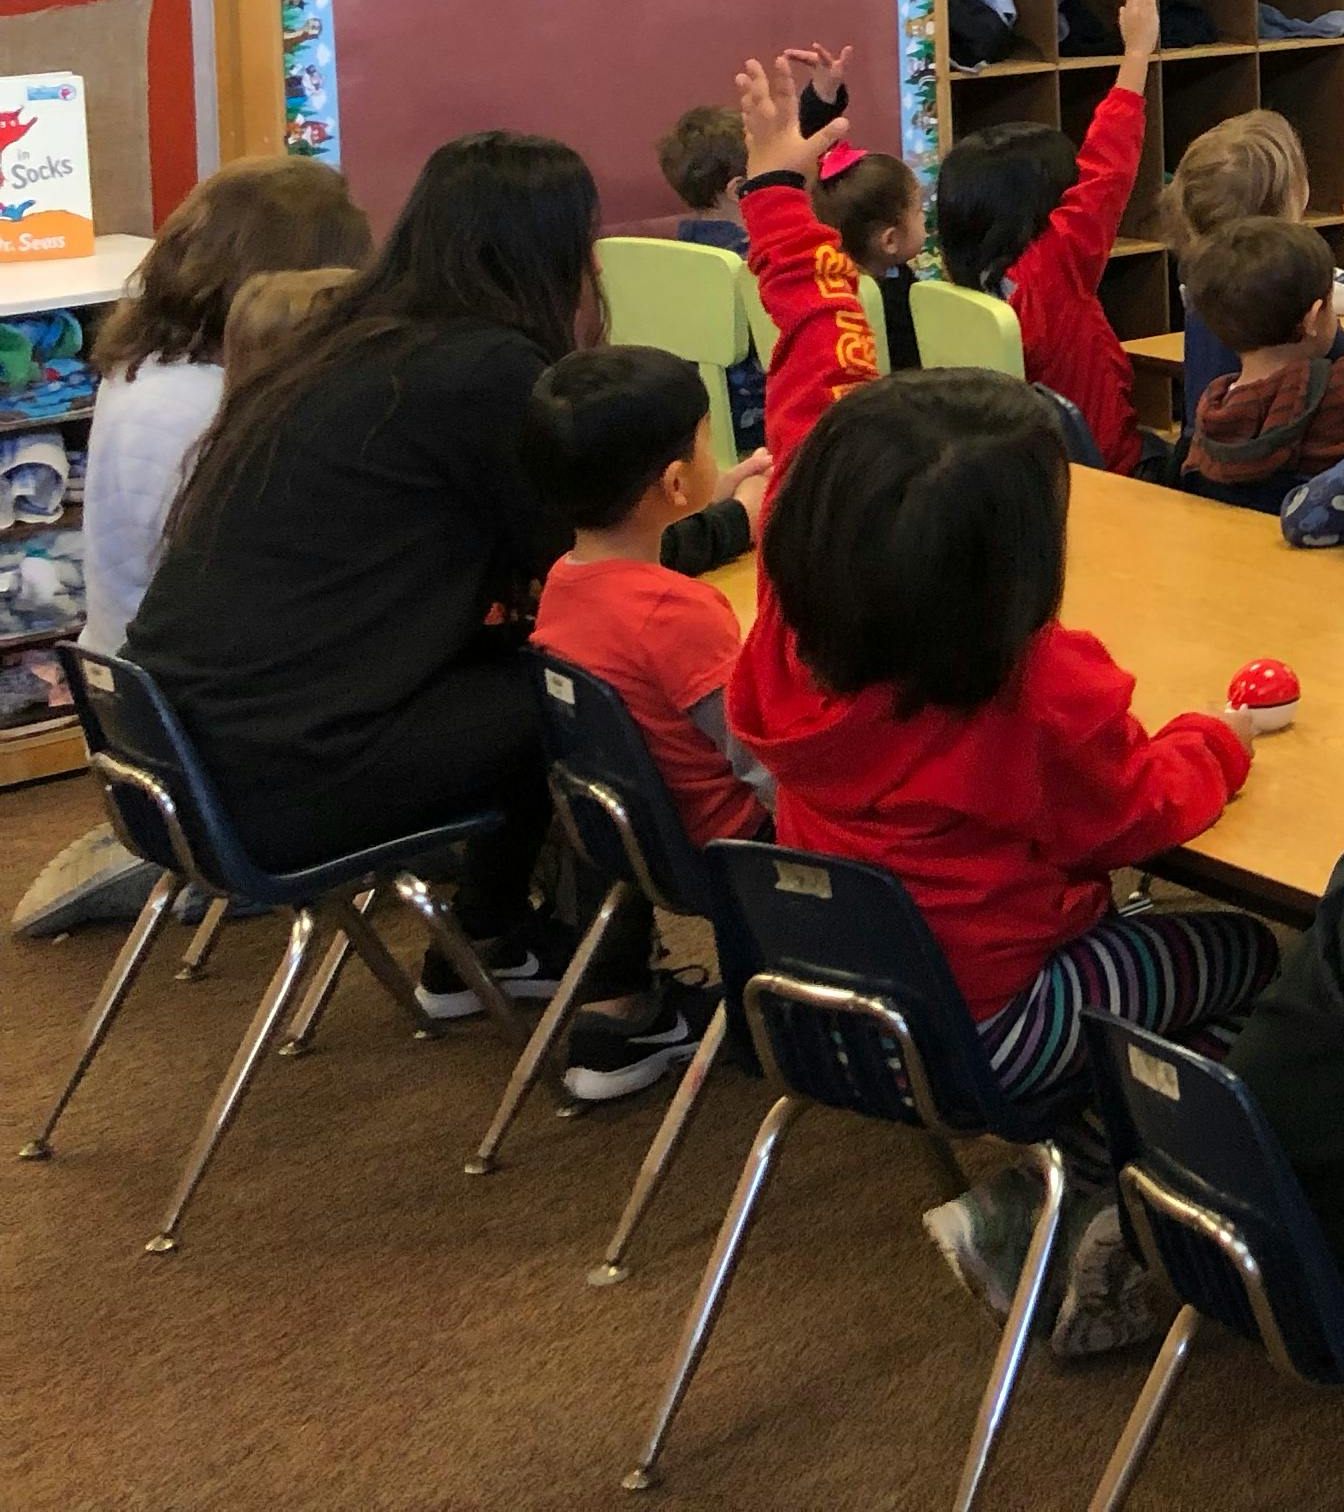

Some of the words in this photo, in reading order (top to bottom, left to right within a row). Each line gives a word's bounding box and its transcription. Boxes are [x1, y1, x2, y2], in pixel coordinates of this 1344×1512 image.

[17, 148, 30, 160] in
[11, 155, 73, 189] Socks
[18, 233, 66, 252] Seuss
